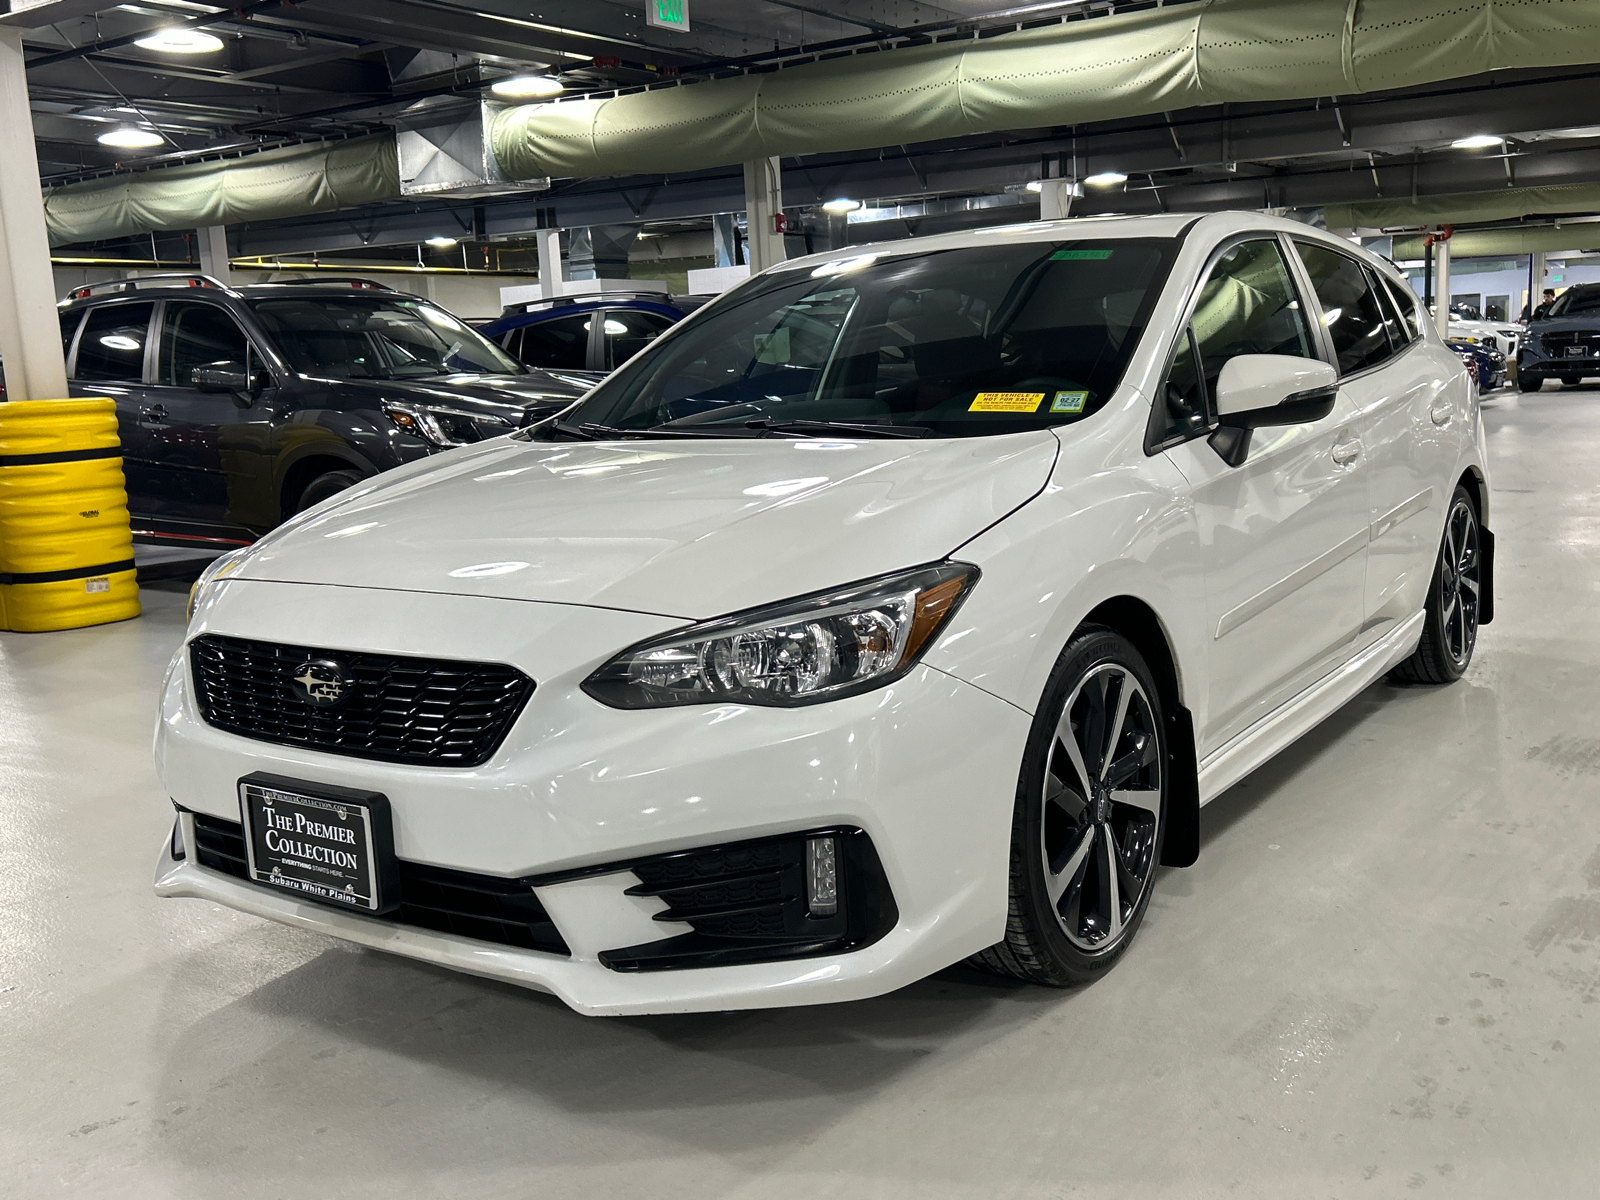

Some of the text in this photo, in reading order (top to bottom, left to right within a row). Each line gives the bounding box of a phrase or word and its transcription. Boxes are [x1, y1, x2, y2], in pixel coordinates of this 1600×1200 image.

[262, 806, 356, 845] THE PREMIER
[265, 830, 358, 870] COLLECTION
[281, 857, 312, 870] EVERYTHING
[312, 863, 330, 874] STARTS
[269, 874, 357, 904] Subaru White Plains
